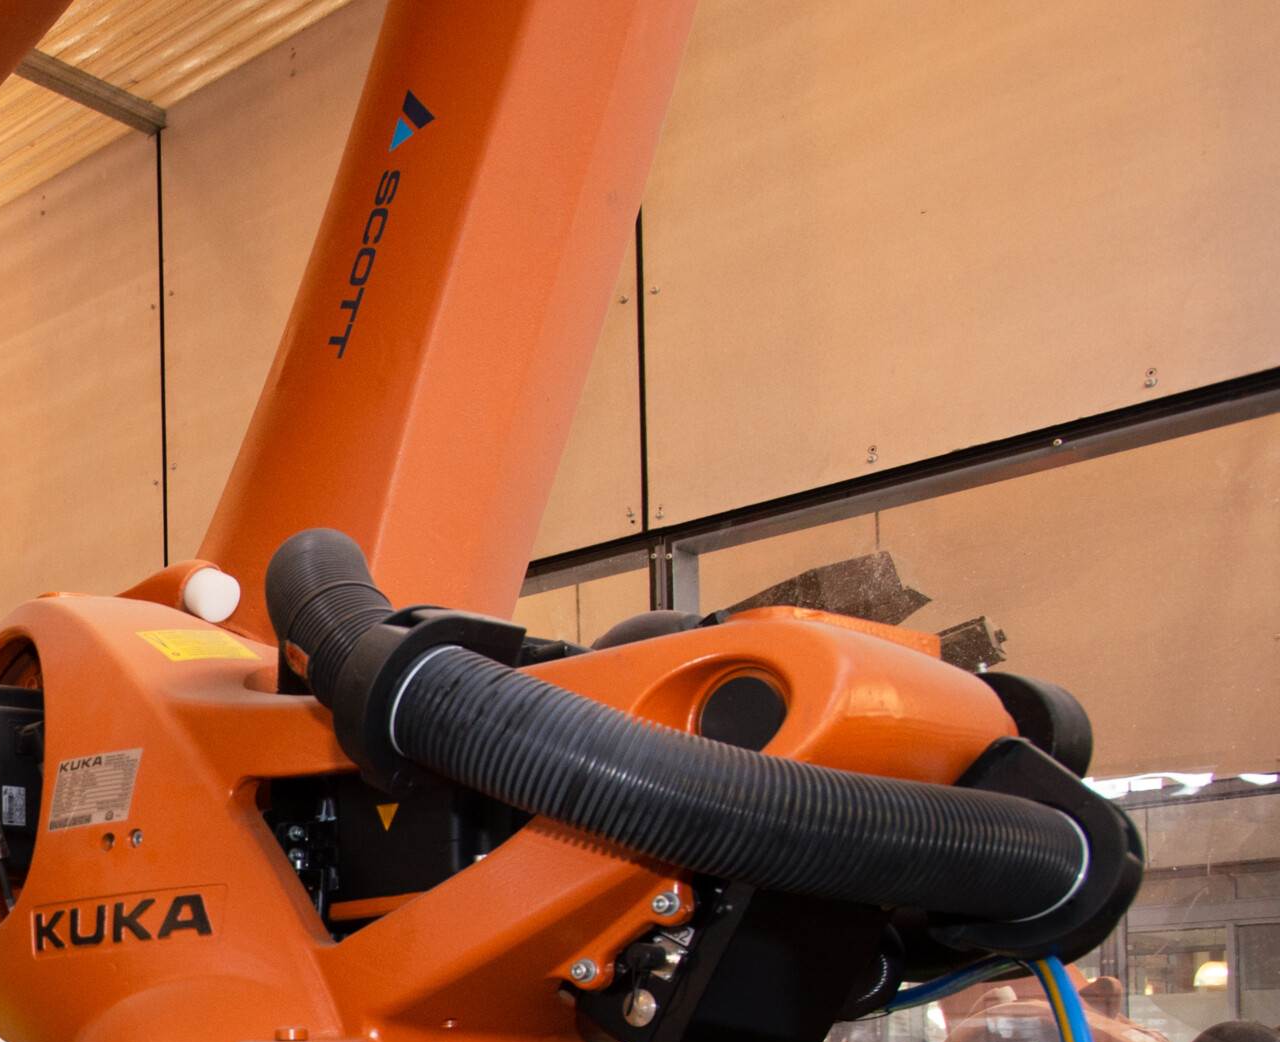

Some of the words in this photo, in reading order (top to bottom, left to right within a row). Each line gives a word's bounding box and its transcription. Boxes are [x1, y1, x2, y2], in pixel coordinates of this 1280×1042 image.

[328, 169, 401, 359] SCOTT
[59, 756, 103, 773] KUKA
[36, 893, 213, 952] KUKA
